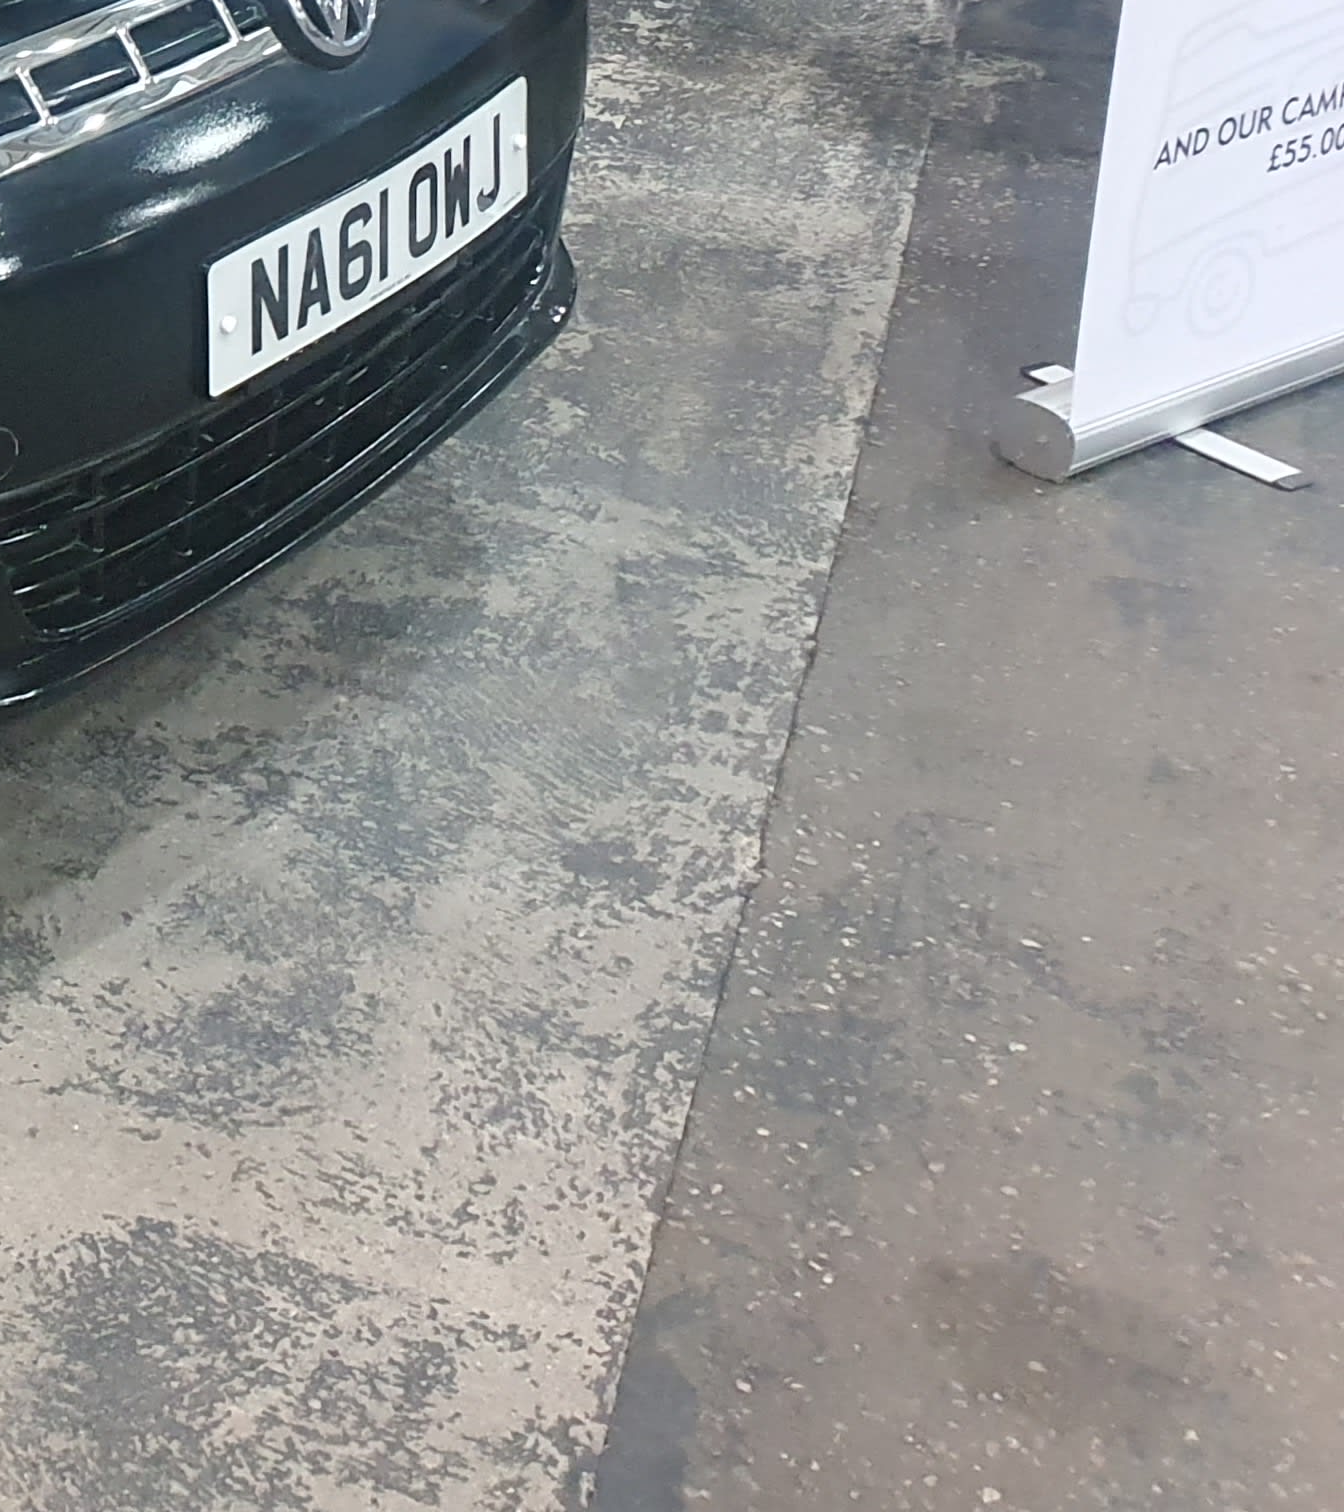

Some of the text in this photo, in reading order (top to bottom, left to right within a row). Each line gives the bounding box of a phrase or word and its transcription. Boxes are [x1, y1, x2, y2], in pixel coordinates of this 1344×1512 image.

[1153, 127, 1209, 171] AND
[1218, 105, 1273, 147] OUR
[251, 113, 501, 357] NA61 OWJ
